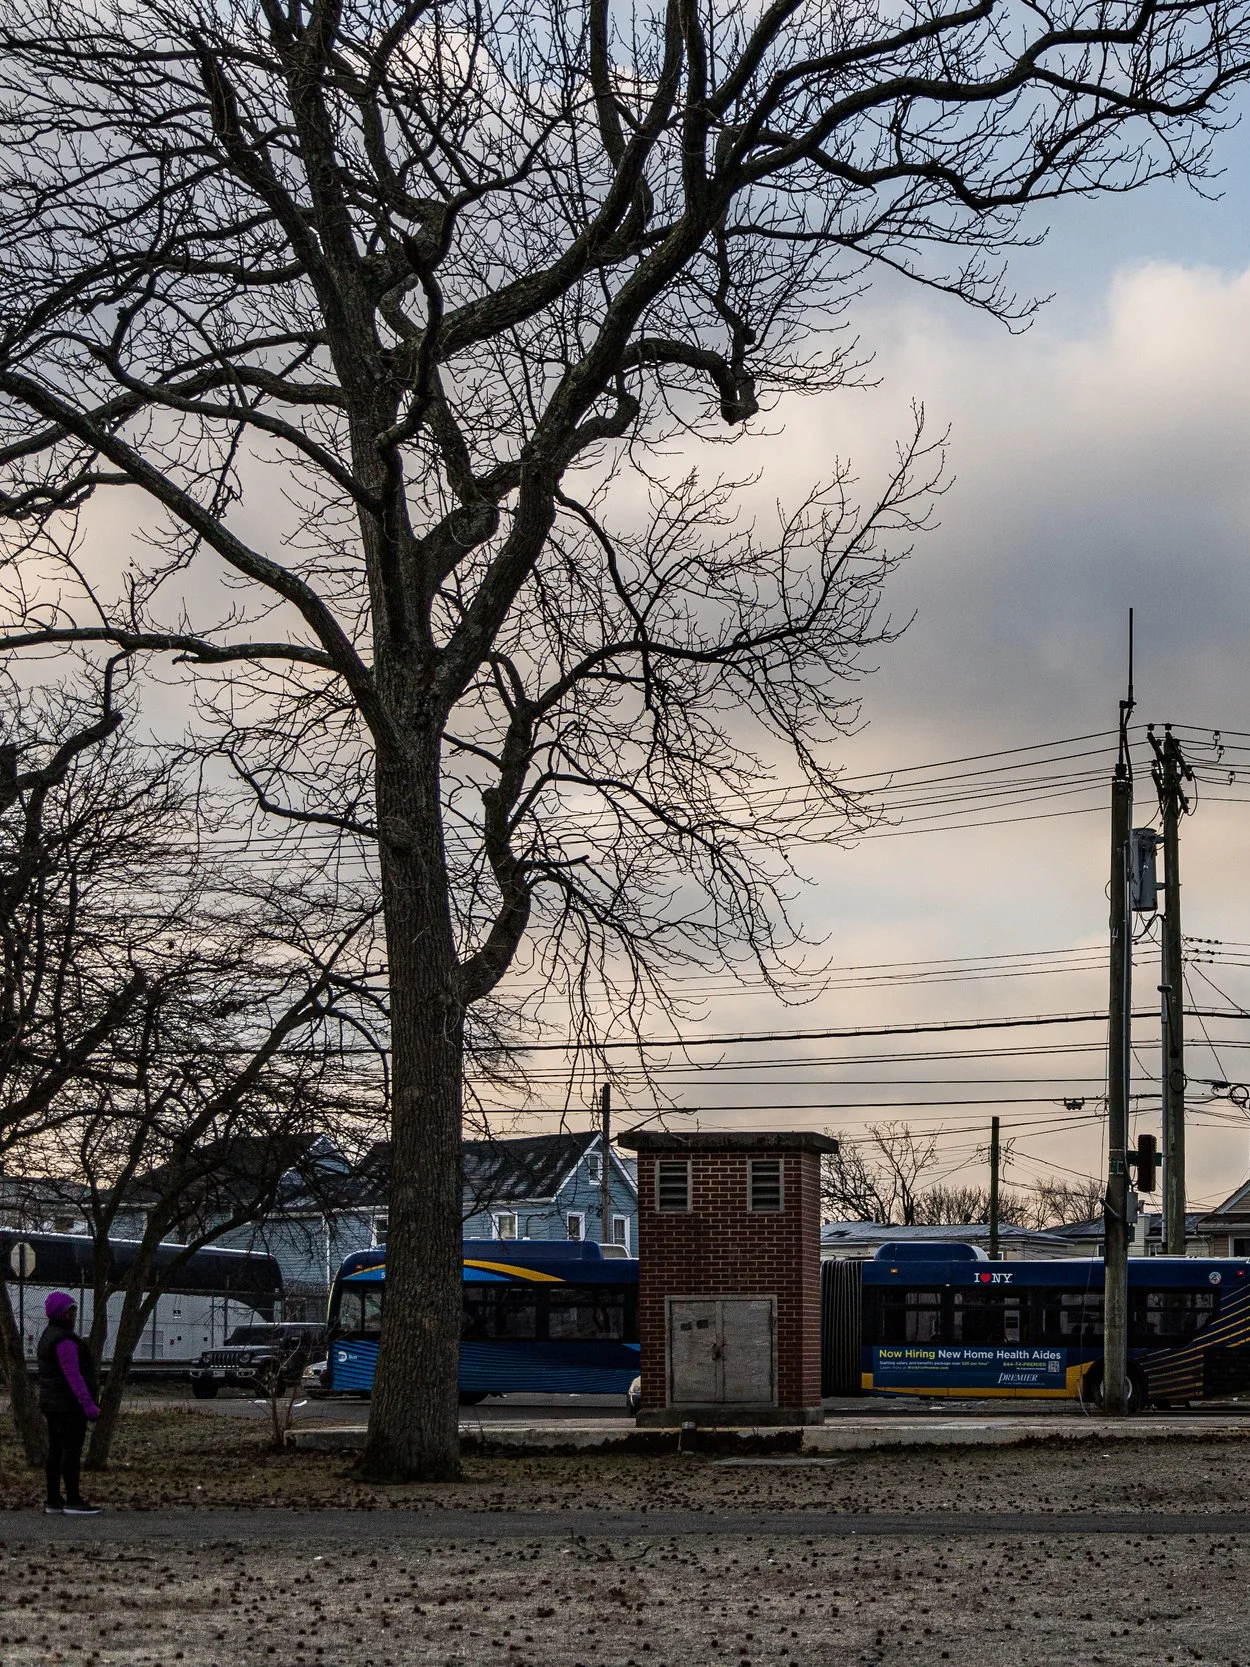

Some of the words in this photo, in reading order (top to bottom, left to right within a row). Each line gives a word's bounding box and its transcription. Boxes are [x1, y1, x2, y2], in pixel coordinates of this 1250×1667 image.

[974, 1272, 981, 1283] I
[879, 1349, 903, 1358] Now
[905, 1349, 936, 1360] Hiring
[938, 1349, 961, 1359] New
[963, 1350, 994, 1359] Home
[996, 1350, 1030, 1359] Health
[1032, 1350, 1061, 1360] Aides
[997, 1372, 1038, 1384] PREMIER
